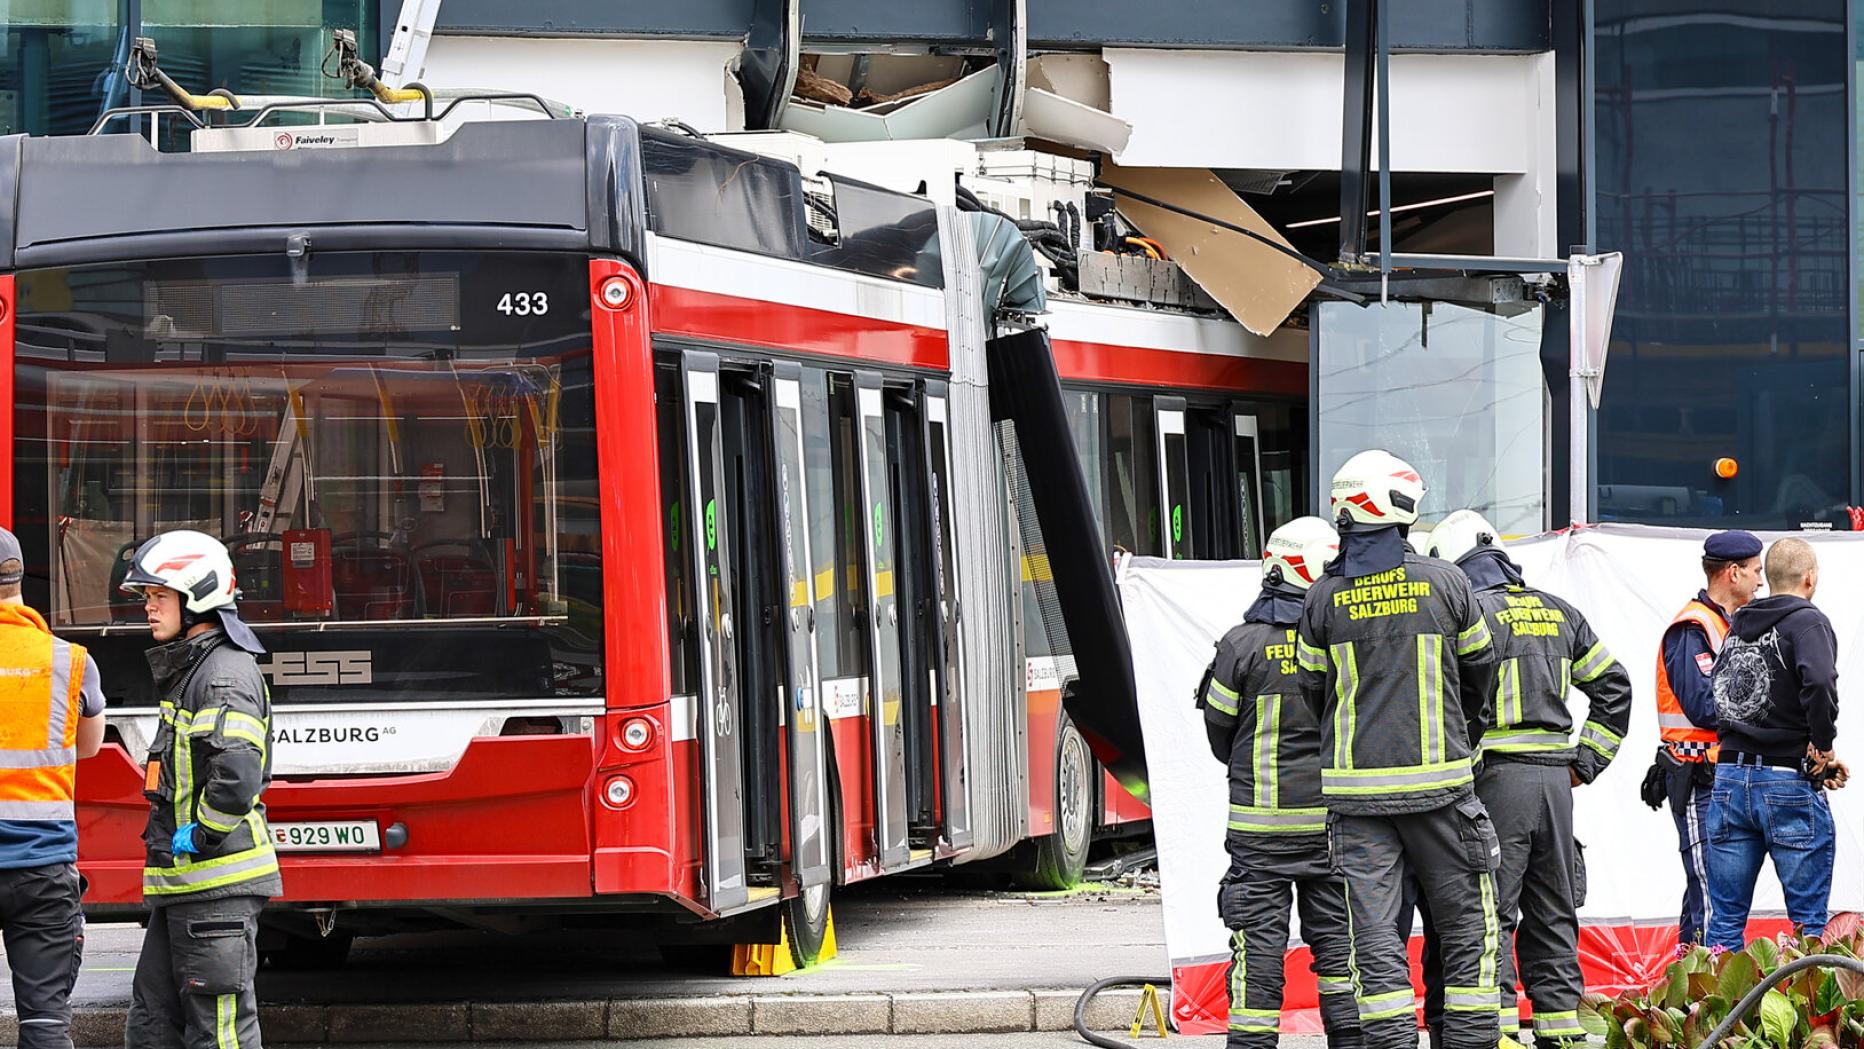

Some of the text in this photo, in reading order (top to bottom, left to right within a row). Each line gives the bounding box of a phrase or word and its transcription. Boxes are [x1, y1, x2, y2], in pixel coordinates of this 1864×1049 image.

[295, 135, 335, 144] Faiveley
[497, 292, 549, 316] 433
[1333, 582, 1431, 608] FEUERWEHR
[1348, 597, 1418, 620] SALZBURG
[382, 727, 397, 735] AG
[290, 827, 331, 846] 929
